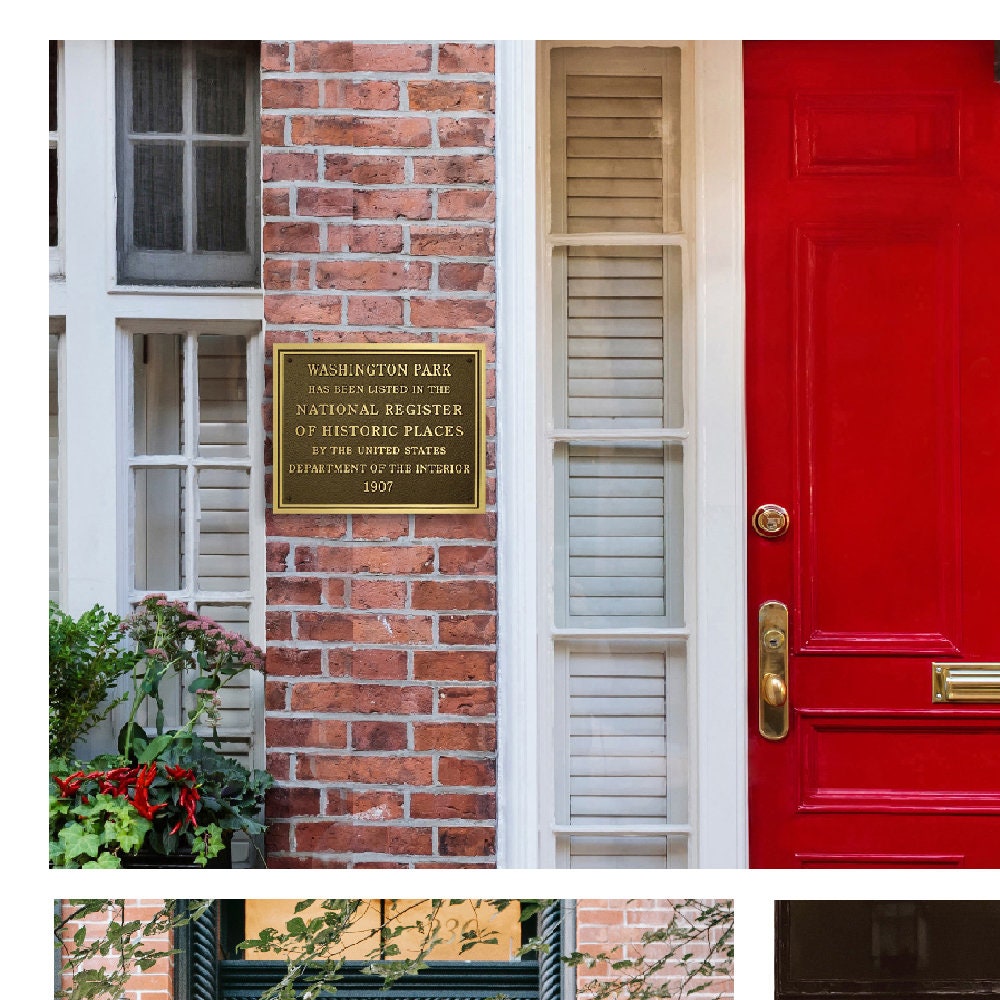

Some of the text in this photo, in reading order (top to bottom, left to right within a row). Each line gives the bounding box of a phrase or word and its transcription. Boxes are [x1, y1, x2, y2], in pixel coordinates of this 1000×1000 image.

[307, 364, 452, 377] WASHINGTON PARK
[308, 385, 450, 394] HAS BEEN LISTED IN THE
[296, 404, 463, 416] NATIONAL REGISTER
[295, 425, 464, 437] OF HISTORIC PLACES
[312, 447, 446, 455] BY THE UNITED STATES
[289, 464, 470, 474] DEPARTMENT OF THE INTERIOR
[363, 481, 393, 493] 1907
